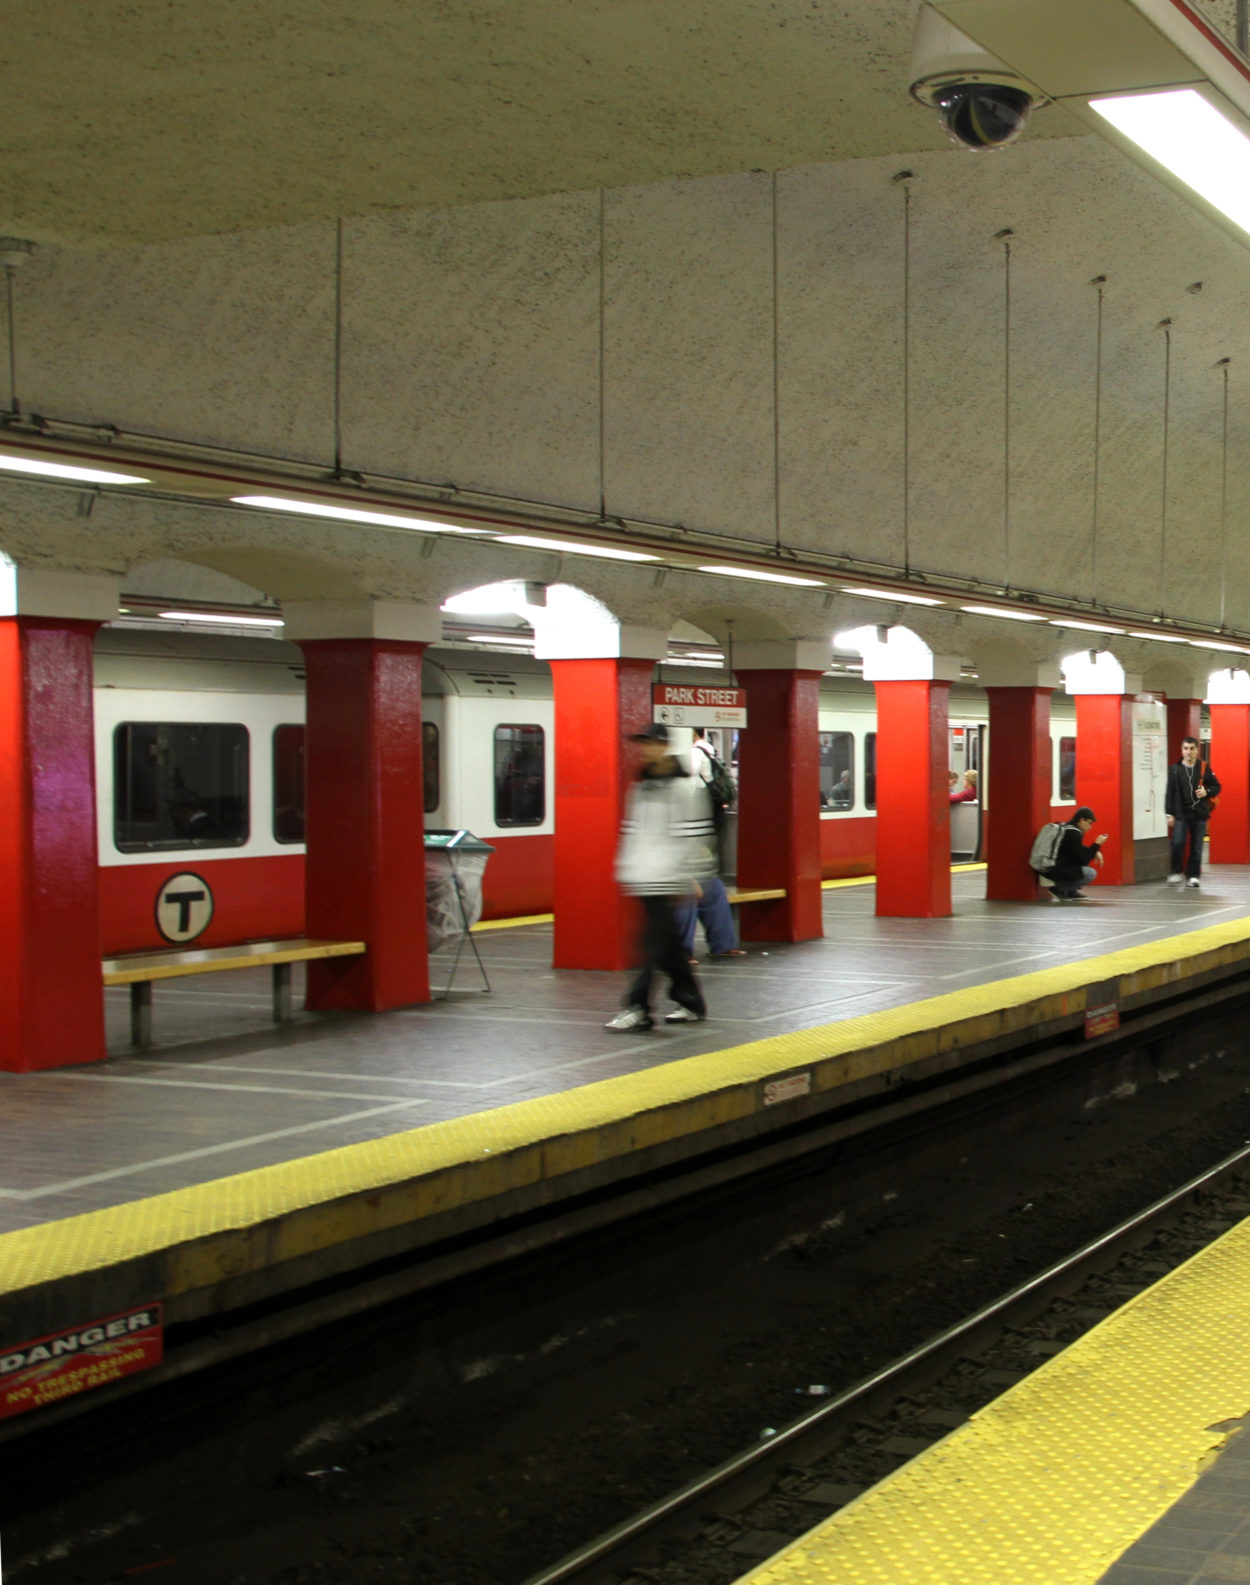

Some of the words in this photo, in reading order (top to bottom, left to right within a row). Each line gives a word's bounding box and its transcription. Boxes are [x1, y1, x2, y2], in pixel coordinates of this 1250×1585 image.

[665, 687, 695, 703] PARK
[696, 689, 739, 705] STREET
[165, 891, 205, 933] T
[0, 1312, 151, 1374] DANGER
[6, 1387, 33, 1404] NO
[37, 1348, 146, 1391] TRESPASSING
